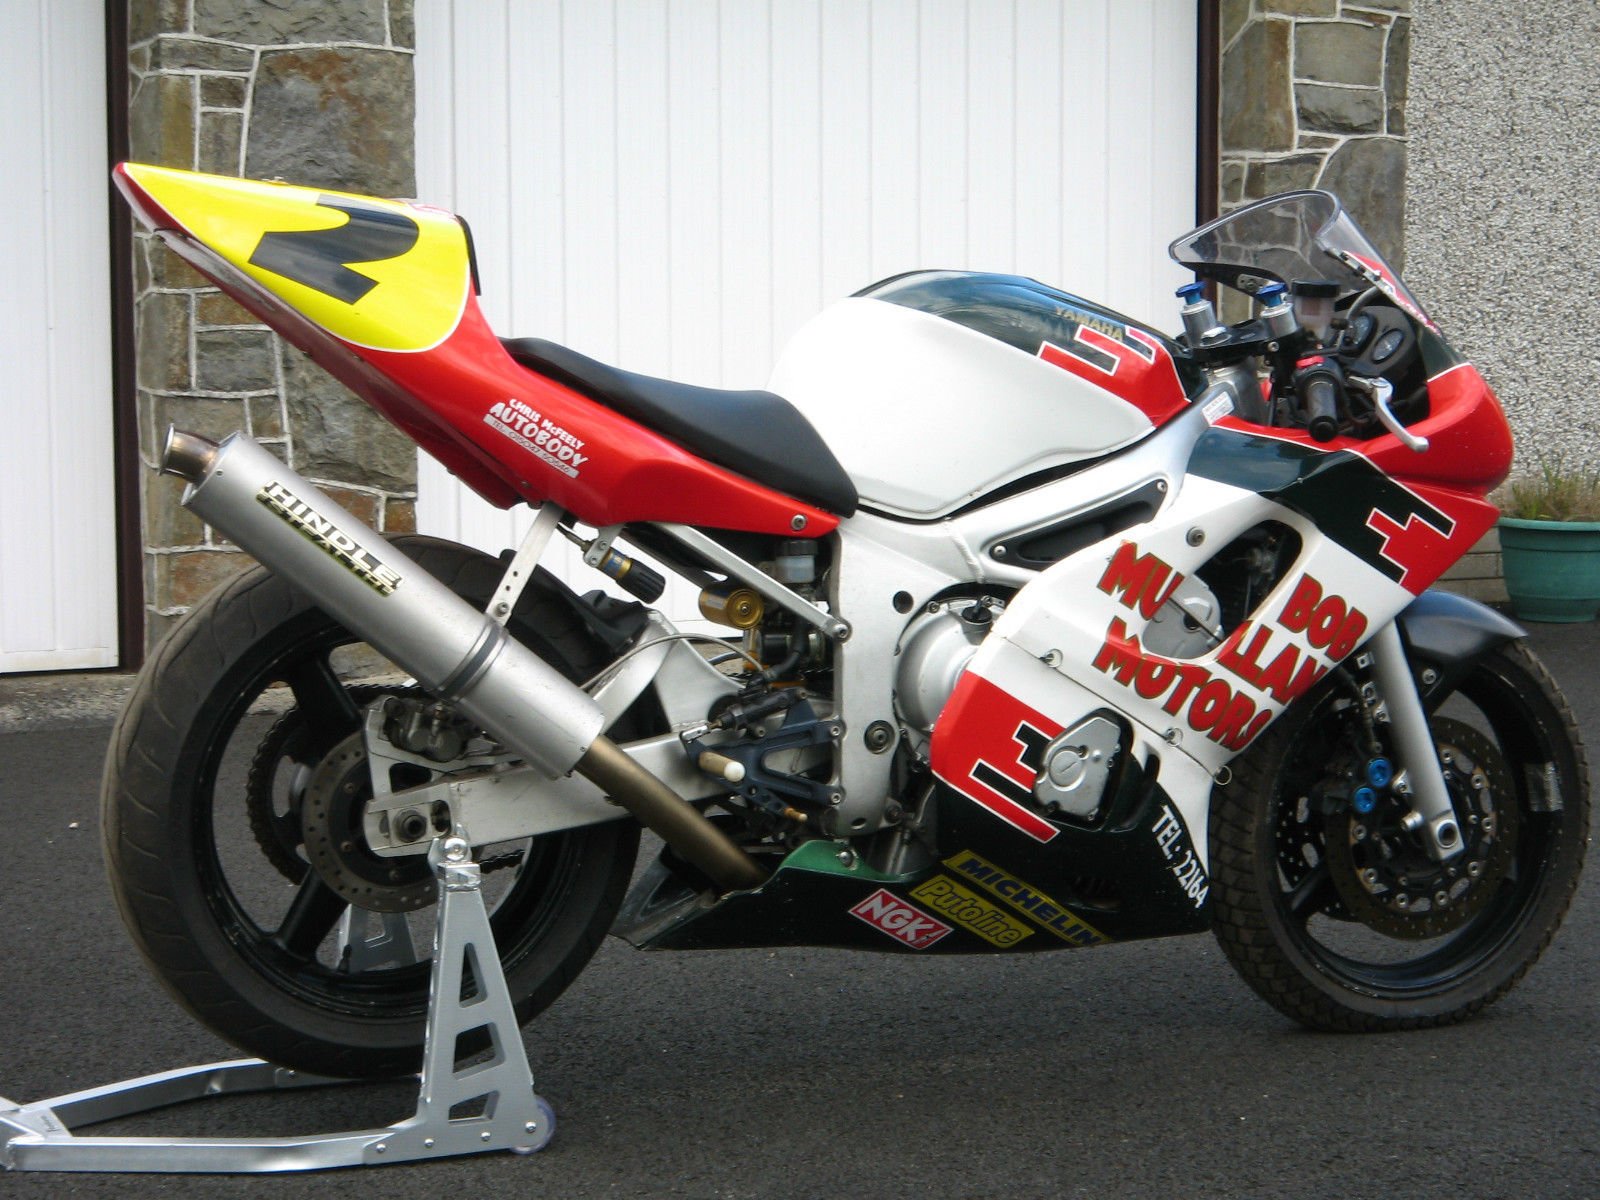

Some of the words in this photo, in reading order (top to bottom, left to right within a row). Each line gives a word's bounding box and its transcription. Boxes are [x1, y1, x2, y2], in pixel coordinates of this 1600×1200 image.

[1056, 307, 1123, 341] YAMAHA
[489, 402, 589, 467] AUTOBODY
[509, 399, 541, 422] CHRIS
[541, 419, 585, 450] McFEELY
[267, 484, 400, 586] HINDLE
[1277, 572, 1367, 663] BOB
[1091, 615, 1272, 751] MOTORS
[858, 895, 935, 942] NGK
[916, 879, 1022, 944] Putoline
[959, 859, 1102, 945] MICHELIN
